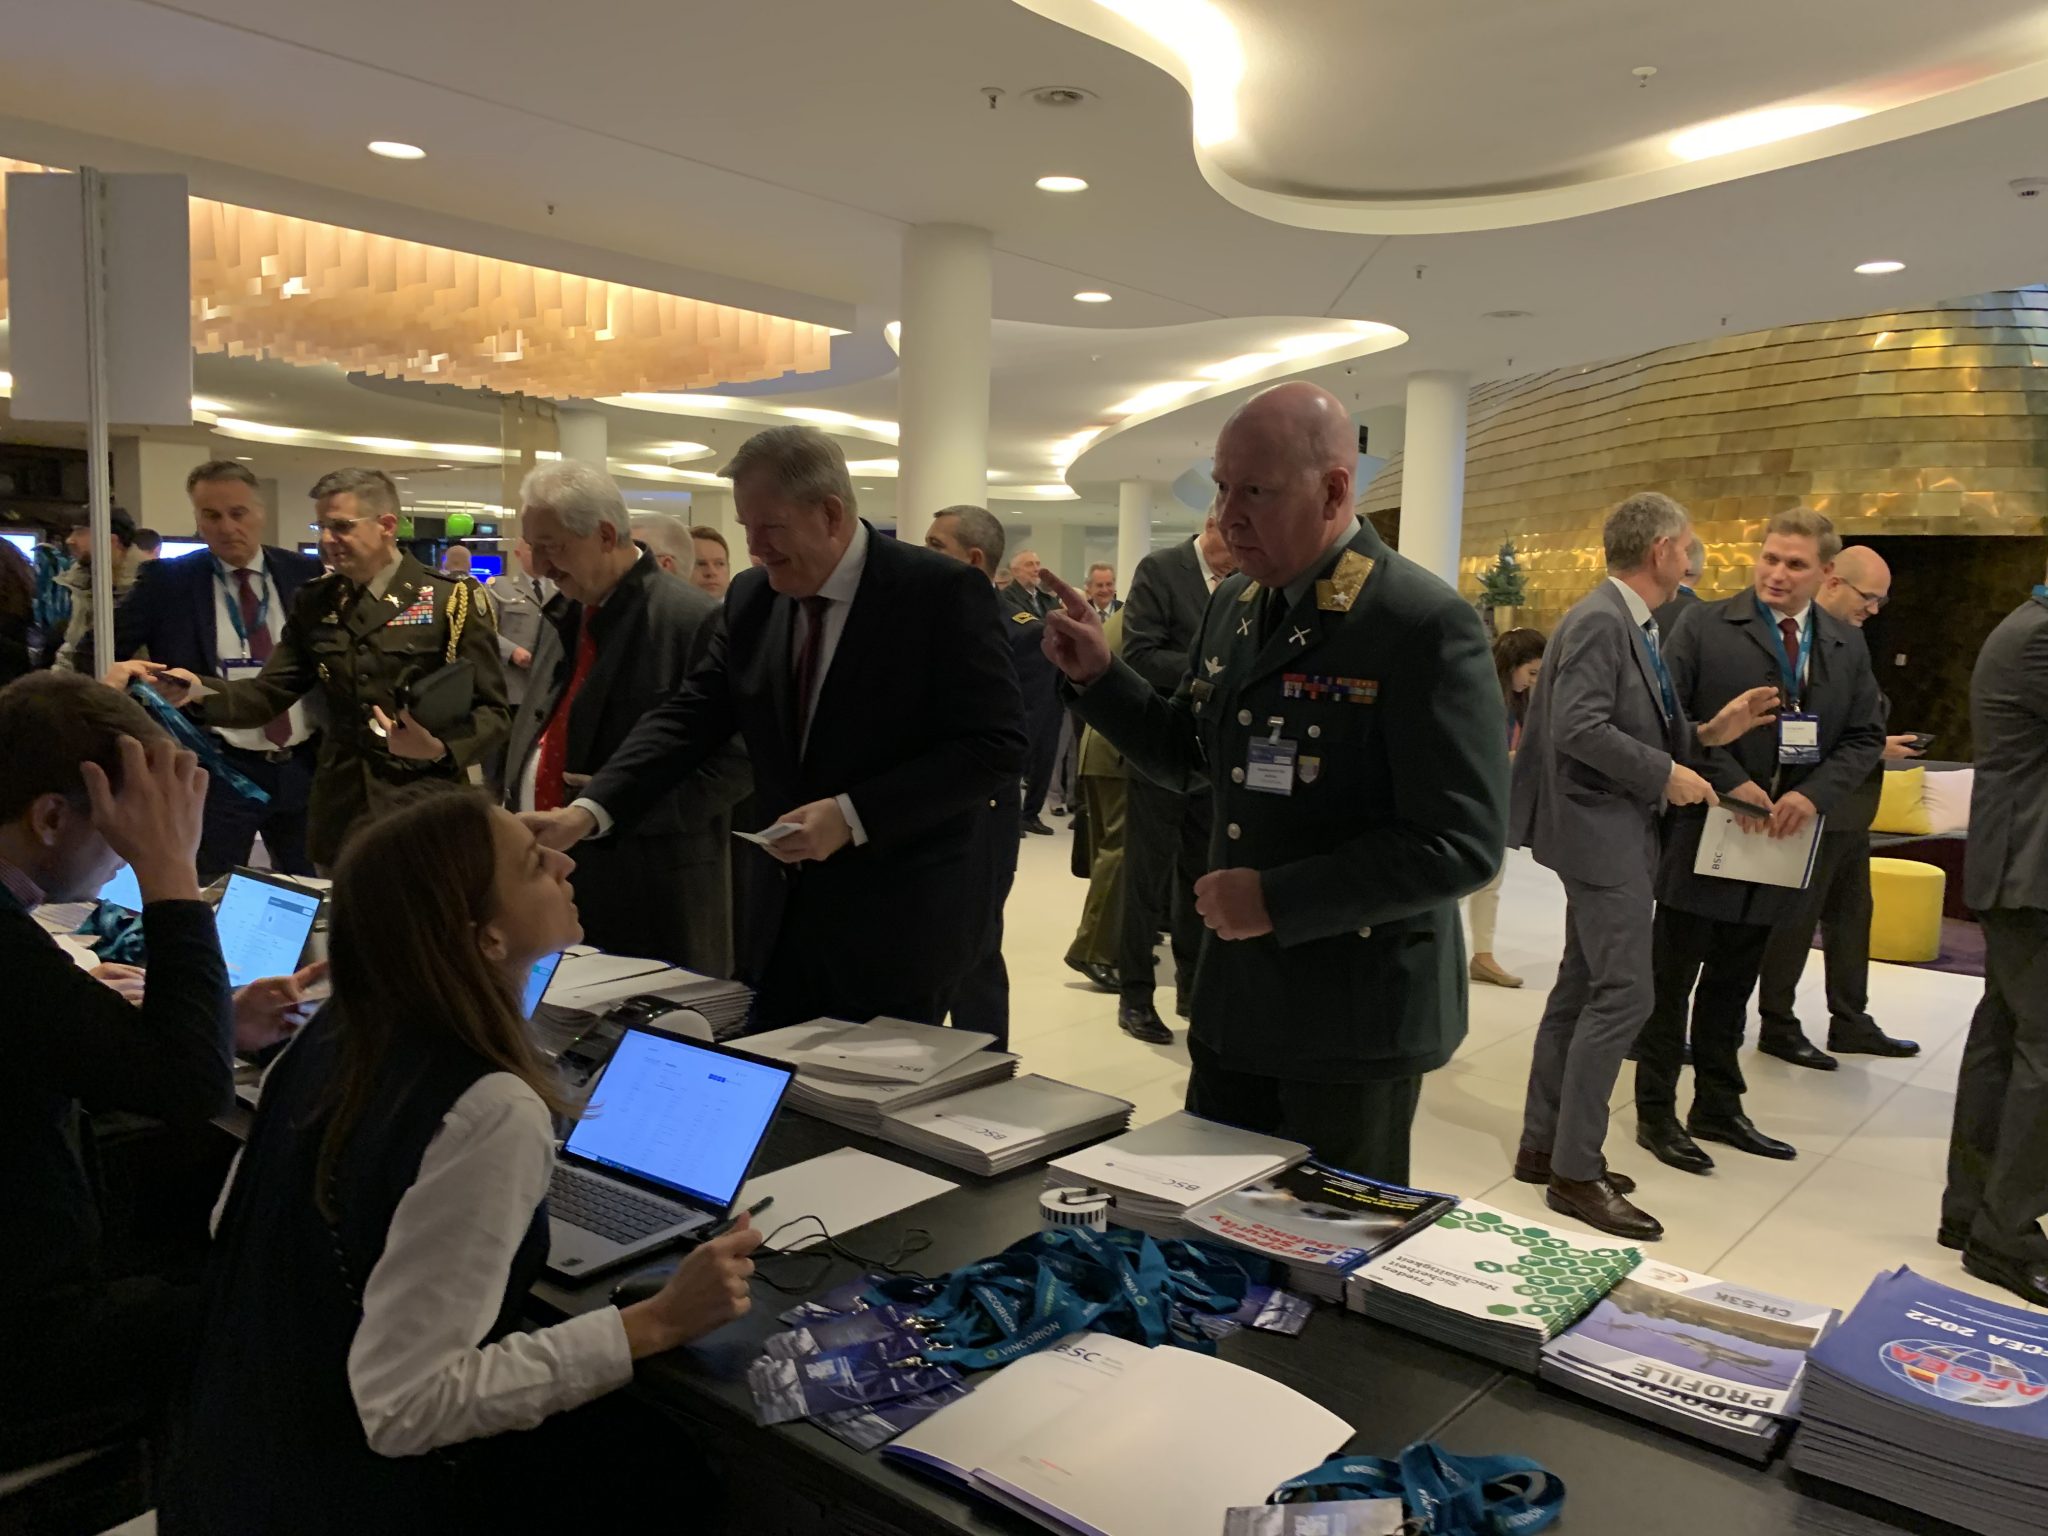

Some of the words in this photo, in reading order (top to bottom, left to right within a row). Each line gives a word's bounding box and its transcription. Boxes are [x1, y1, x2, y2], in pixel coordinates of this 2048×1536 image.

[976, 1128, 1007, 1140] BSC
[1161, 1178, 1200, 1191] BSC
[1209, 1214, 1299, 1248] Security
[1219, 1227, 1317, 1259] European
[1381, 1265, 1433, 1287] Frieden
[1388, 1261, 1459, 1287] Sicherheit
[1396, 1255, 1500, 1291] Nachhaltigkeit
[1714, 1291, 1792, 1318] CH-53K
[1904, 1309, 1978, 1337] 2022
[1000, 1320, 1061, 1357] VINCORION
[1053, 1343, 1102, 1362] BSC
[1890, 1344, 2046, 1396] AFCEA
[1630, 1363, 1775, 1410] PROFILE
